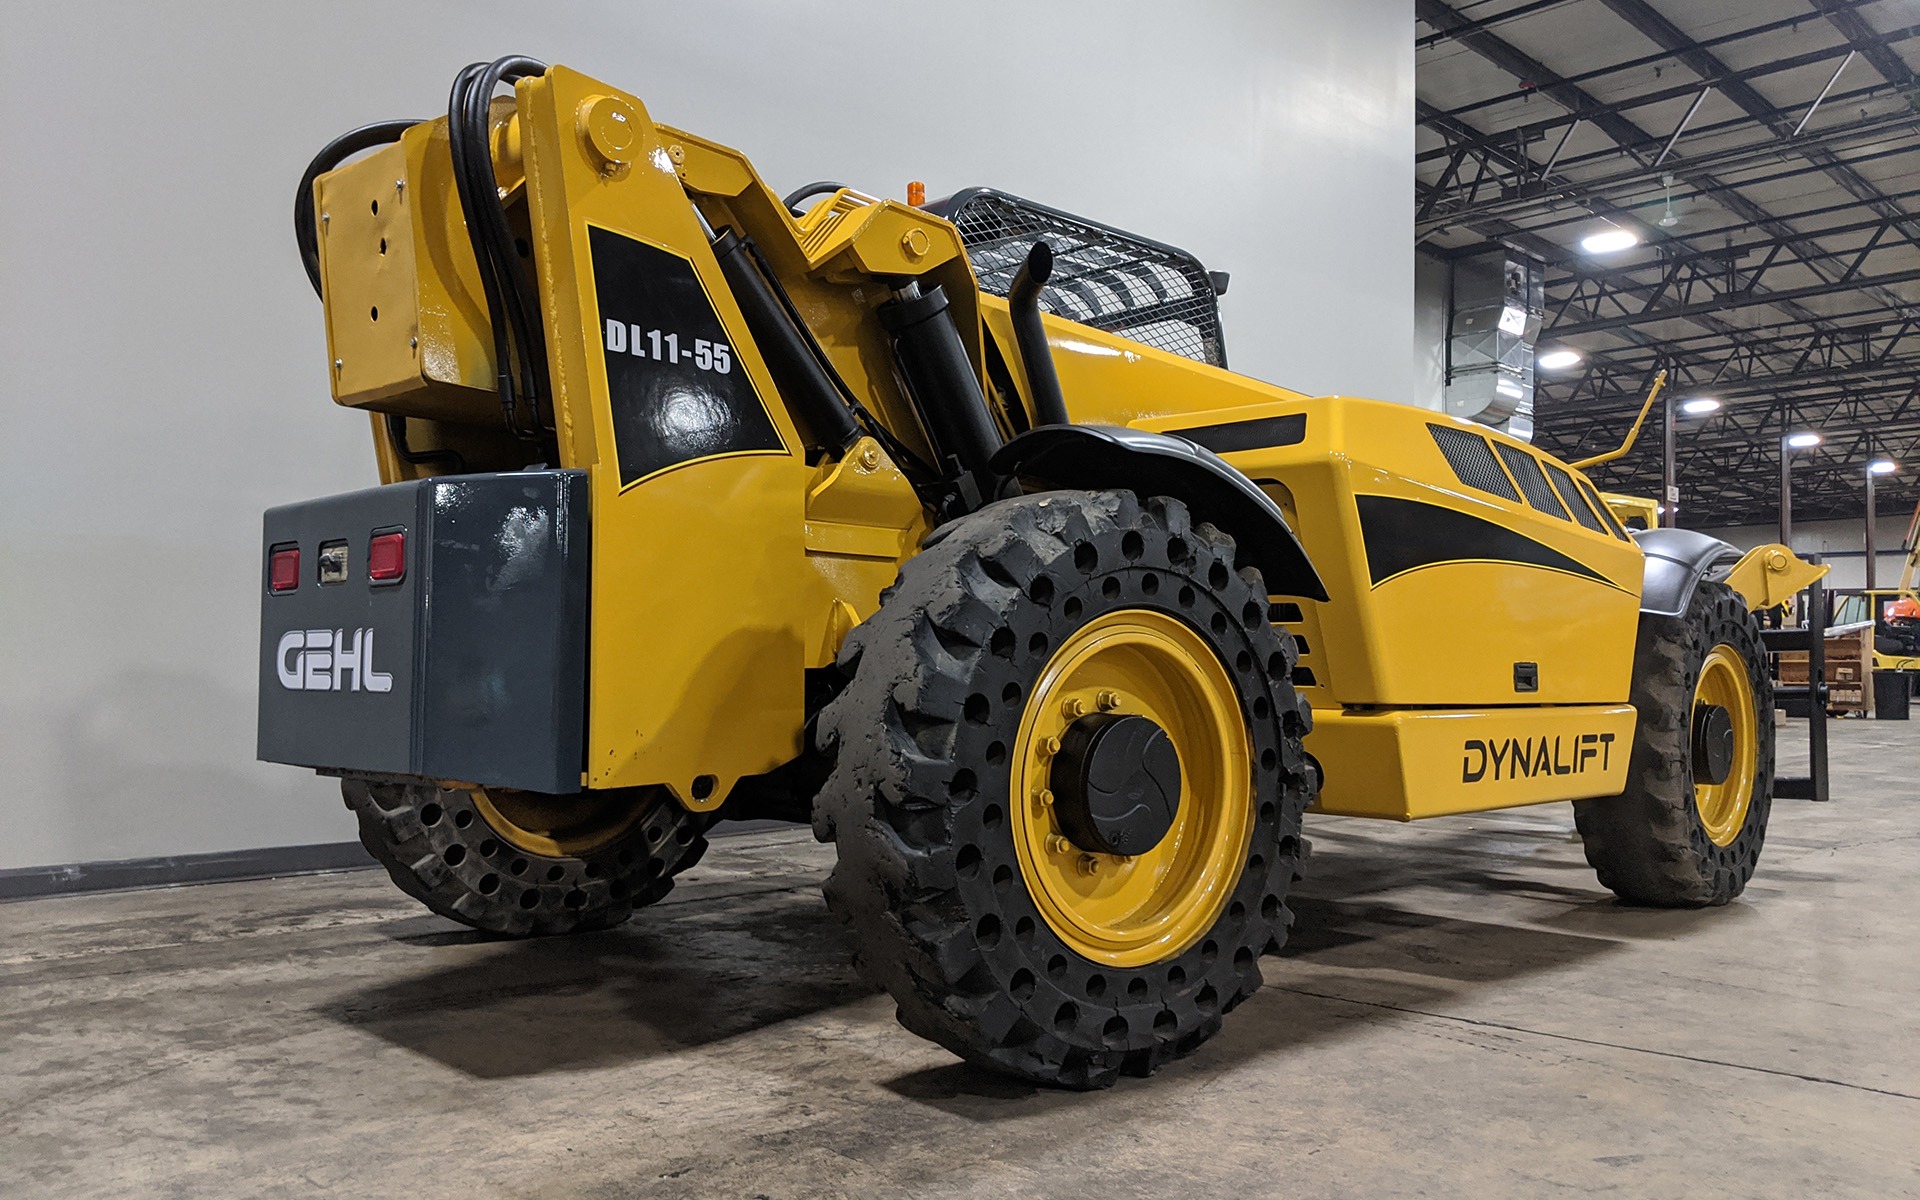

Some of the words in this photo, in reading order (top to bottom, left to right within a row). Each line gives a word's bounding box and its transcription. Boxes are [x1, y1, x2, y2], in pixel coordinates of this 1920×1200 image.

[606, 318, 732, 375] DL11-55
[276, 627, 394, 693] GEHL
[1462, 733, 1616, 784] DYNALIFT
